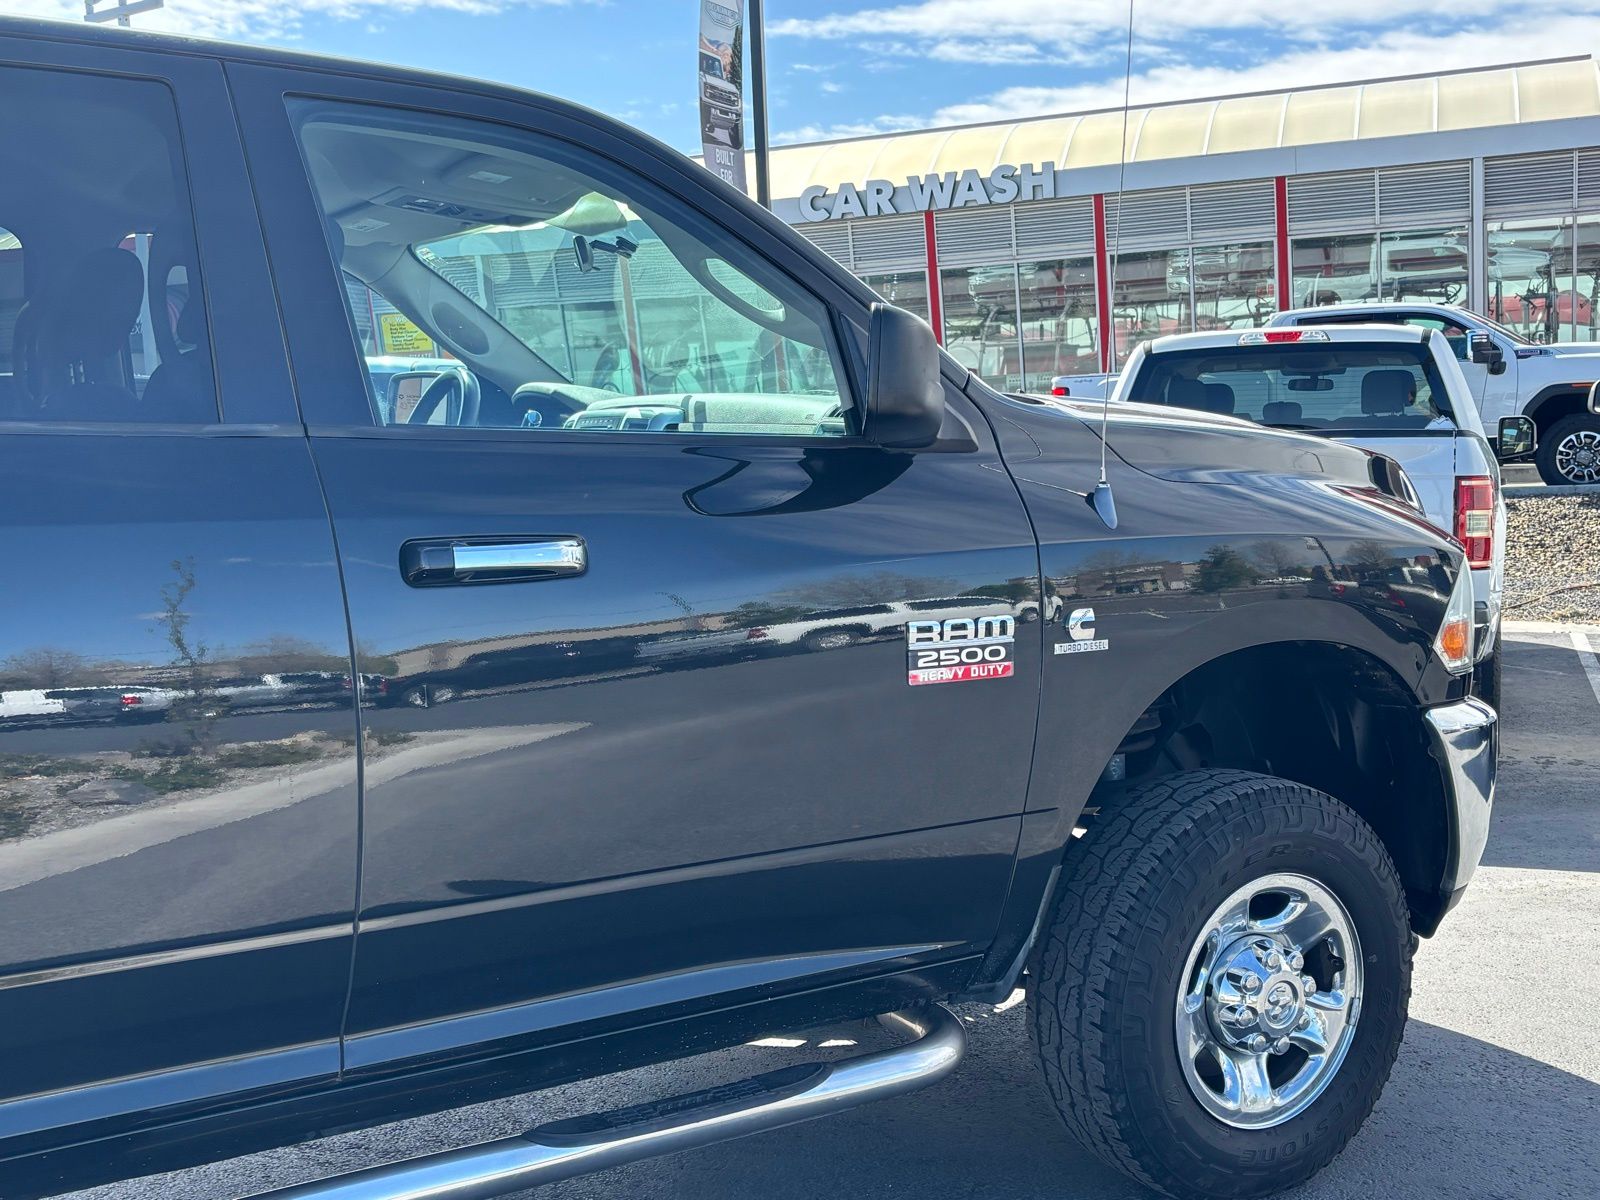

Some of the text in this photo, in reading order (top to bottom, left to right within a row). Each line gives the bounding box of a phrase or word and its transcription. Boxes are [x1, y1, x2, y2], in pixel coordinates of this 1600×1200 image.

[715, 148, 735, 167] BUILT
[720, 168, 734, 185] FOR
[799, 161, 1056, 223] CAR WASH
[906, 614, 1015, 644] RAM
[917, 645, 1006, 668] 2500
[1059, 641, 1106, 653] TURBO DIESEL
[919, 663, 1006, 683] HEAVY DUTY
